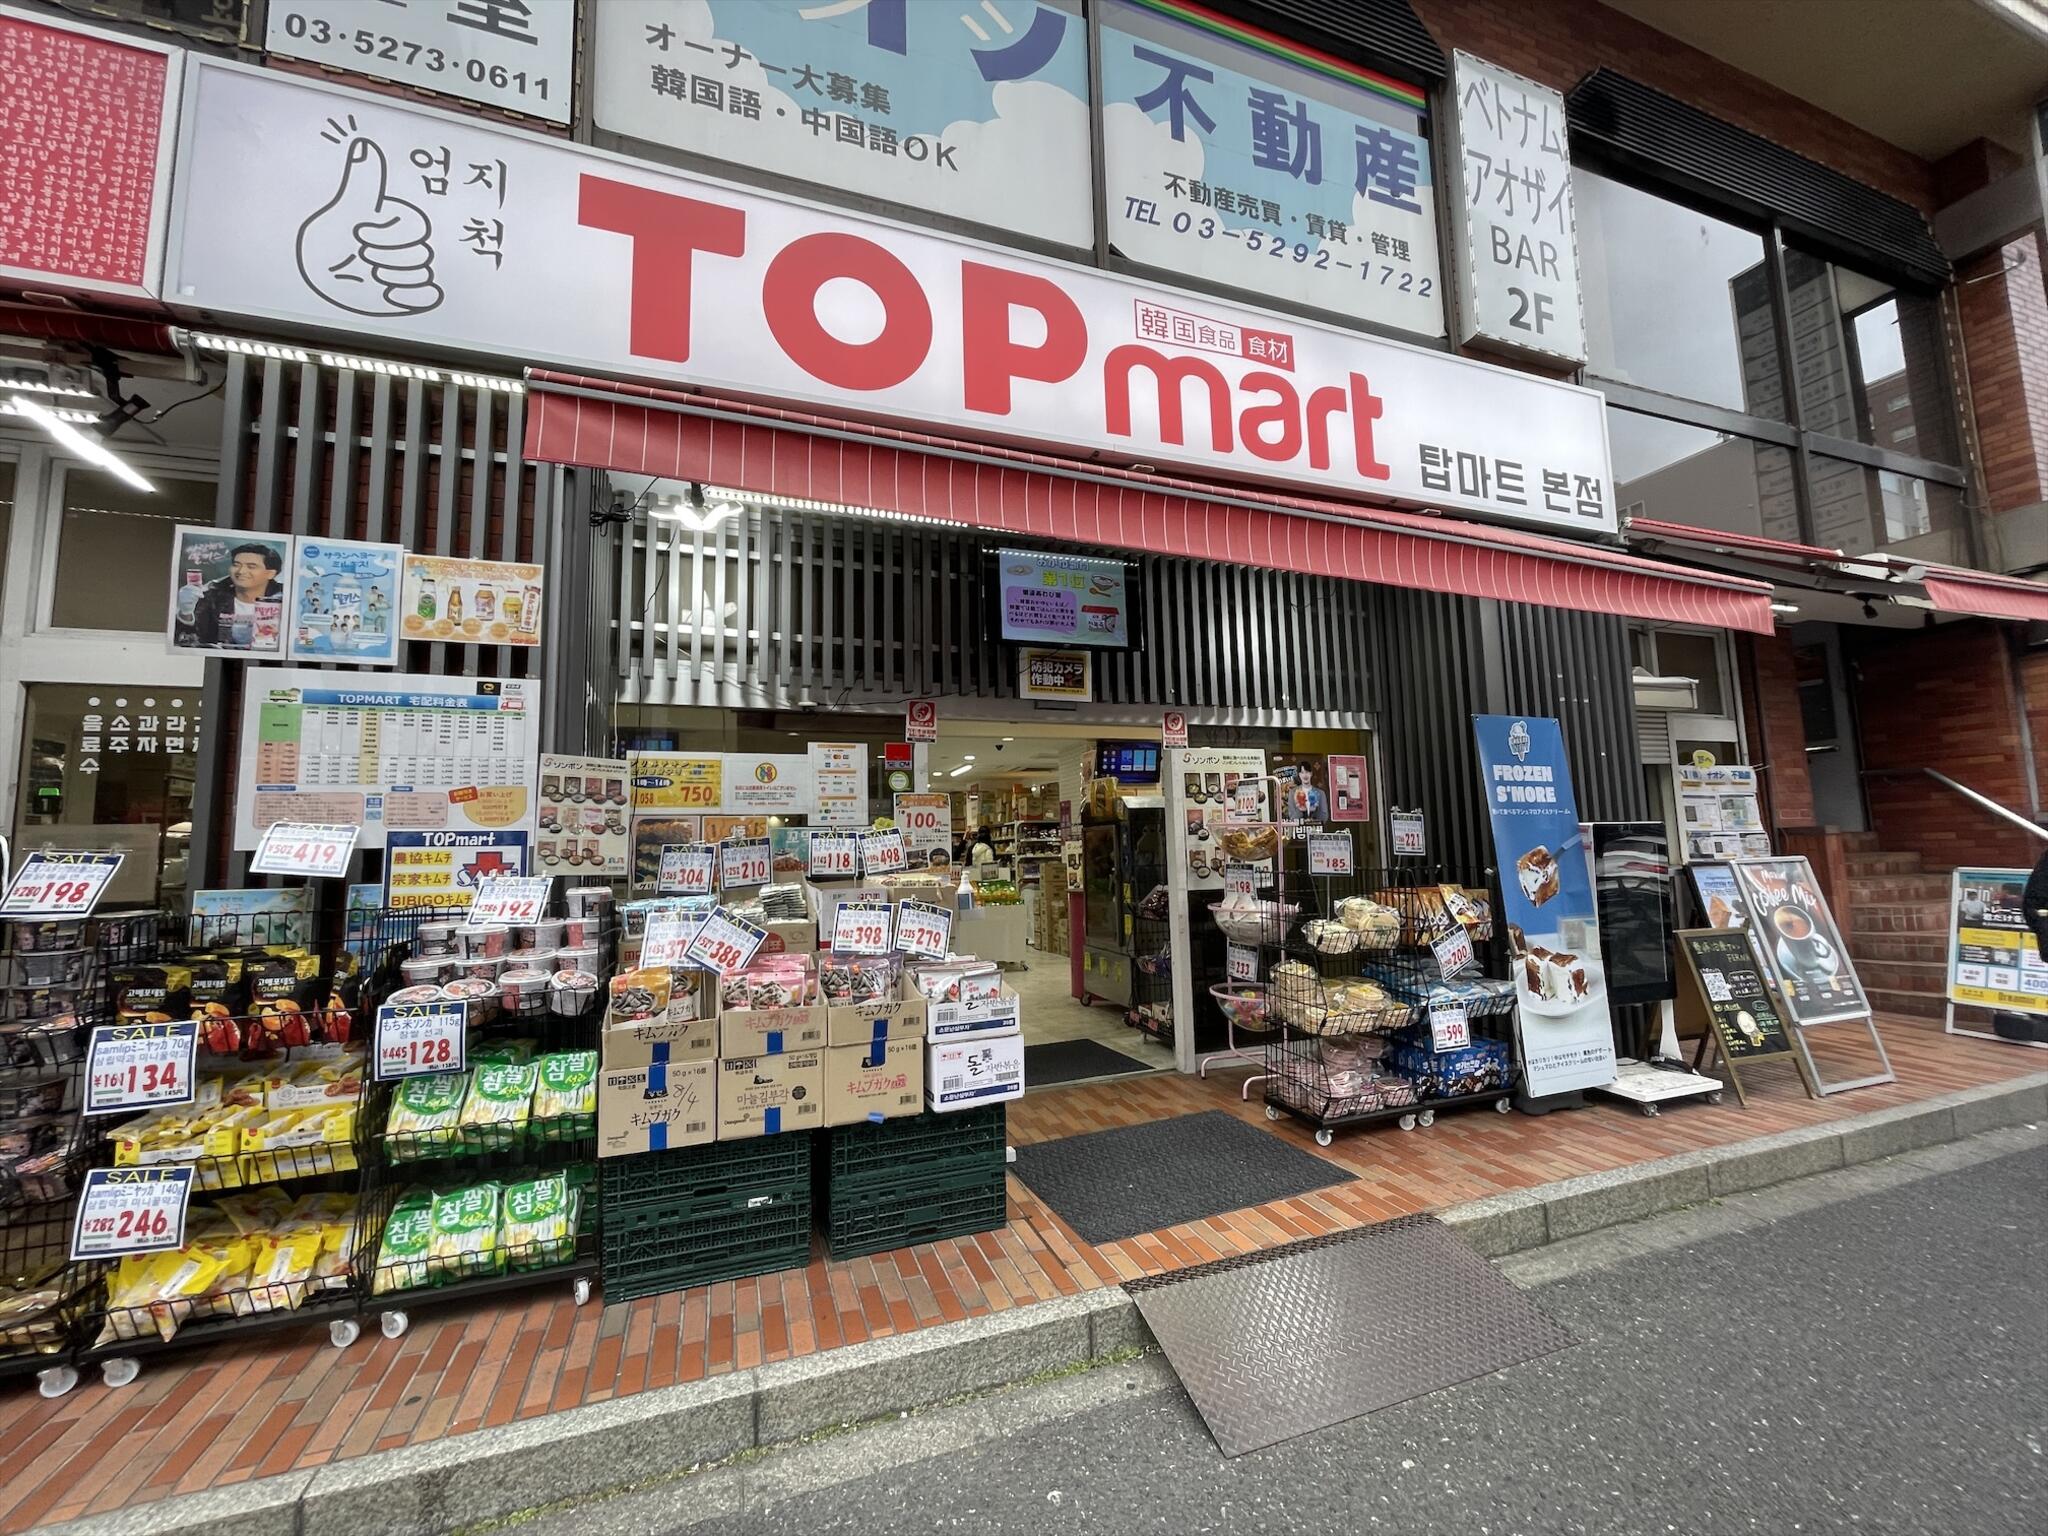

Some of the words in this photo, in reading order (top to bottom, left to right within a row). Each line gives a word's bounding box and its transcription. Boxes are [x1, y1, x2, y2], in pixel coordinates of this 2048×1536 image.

[645, 22, 893, 116] オーナー大募集
[650, 63, 960, 173] 韓国語・中国語OK
[1463, 77, 1567, 157] ベトナム
[1133, 44, 1423, 216] 不動産
[408, 144, 509, 210] 엄지
[1466, 147, 1572, 235] アオザイ
[1124, 196, 1161, 227] TEL
[1162, 170, 1412, 263] 不動産売買・賃貸・管理
[457, 216, 506, 272] 척
[1489, 225, 1562, 282] BAR
[1507, 286, 1556, 335] 2F
[1247, 335, 1290, 367] 食材
[1418, 443, 1528, 505] 탑마트
[1542, 467, 1605, 520] 본점
[1031, 660, 1084, 675] 防犯カメラ
[1031, 673, 1065, 687] 作動中
[337, 693, 403, 706] TOPMART
[108, 714, 131, 754] 소주
[136, 715, 160, 754] 과자
[165, 715, 188, 754] 라면
[1491, 764, 1555, 783] FROZEN
[680, 785, 714, 803] 750
[1495, 785, 1558, 804] S'MORE
[422, 831, 497, 847] TOPmart
[43, 853, 106, 866] SALE
[293, 842, 337, 864] 419
[393, 851, 453, 866] 農協キムチ
[828, 852, 851, 869] 118
[880, 847, 901, 865] 498
[1326, 858, 1346, 869] 185
[391, 872, 453, 887] 宗家キムチ
[677, 868, 705, 886] 304
[741, 861, 766, 880] 210
[38, 881, 91, 904] 198
[391, 893, 474, 907] BIBIGOキムチ
[498, 900, 535, 917] 192
[854, 926, 883, 945] 398
[915, 927, 943, 949] 279
[709, 939, 742, 969] 388
[1451, 945, 1469, 966] 200
[393, 1004, 452, 1019] SALE
[439, 1016, 461, 1027] 115g
[111, 1024, 182, 1041] SALE
[1446, 1023, 1464, 1042] 599
[171, 1038, 191, 1050] 70g
[409, 1038, 451, 1066] 128
[127, 1061, 178, 1094] 134
[482, 1064, 526, 1092] 참쌀
[546, 1052, 587, 1082] 참쌀
[407, 1074, 452, 1105] 참쌀
[105, 1168, 177, 1185] SALE
[161, 1183, 184, 1197] 140g
[511, 1180, 556, 1215] 참쌀
[439, 1188, 485, 1225] 참쌀
[116, 1208, 169, 1240] 246
[387, 1209, 432, 1246] 참쌀
